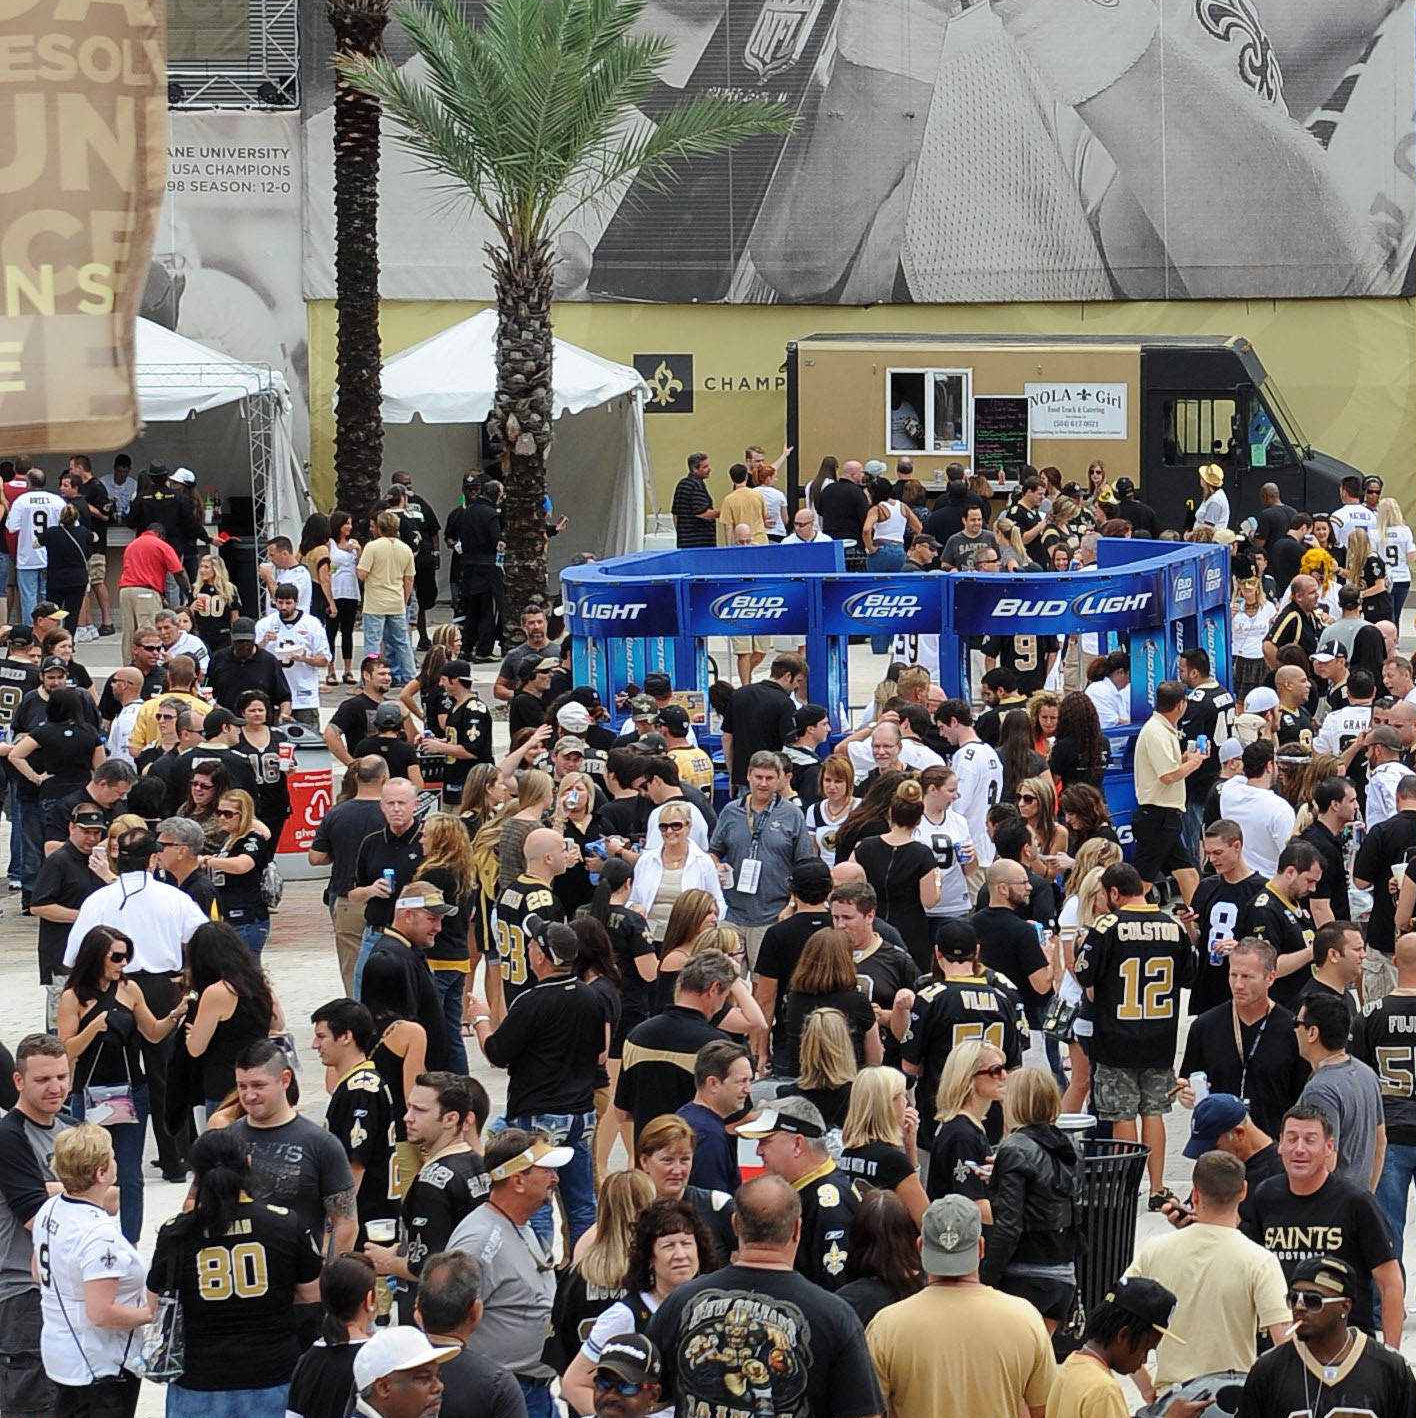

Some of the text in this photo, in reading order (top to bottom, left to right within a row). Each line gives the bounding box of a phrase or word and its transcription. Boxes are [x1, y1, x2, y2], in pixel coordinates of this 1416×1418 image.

[200, 148, 290, 159] UNIVERSITY
[172, 164, 291, 176] USA CHAMPIONS
[190, 181, 291, 193] SEASON: 12-0
[1029, 388, 1121, 409] NOLA Girl
[1207, 567, 1221, 580] BUD
[1178, 577, 1193, 590] BUD
[730, 595, 786, 609] BUD
[863, 594, 919, 608] BUD
[1175, 588, 1193, 602] LIGHT
[580, 602, 647, 621] LIGHT
[992, 592, 1153, 617] BUD LIGHT
[719, 607, 788, 621] LIGHT
[852, 606, 922, 620] LIGHT
[1015, 634, 1039, 672] 9
[1117, 921, 1180, 942] COLSTON
[1208, 901, 1239, 954] 8
[1117, 956, 1175, 1020] 12
[1265, 1226, 1343, 1250] SAINTS
[197, 1242, 270, 1301] 80
